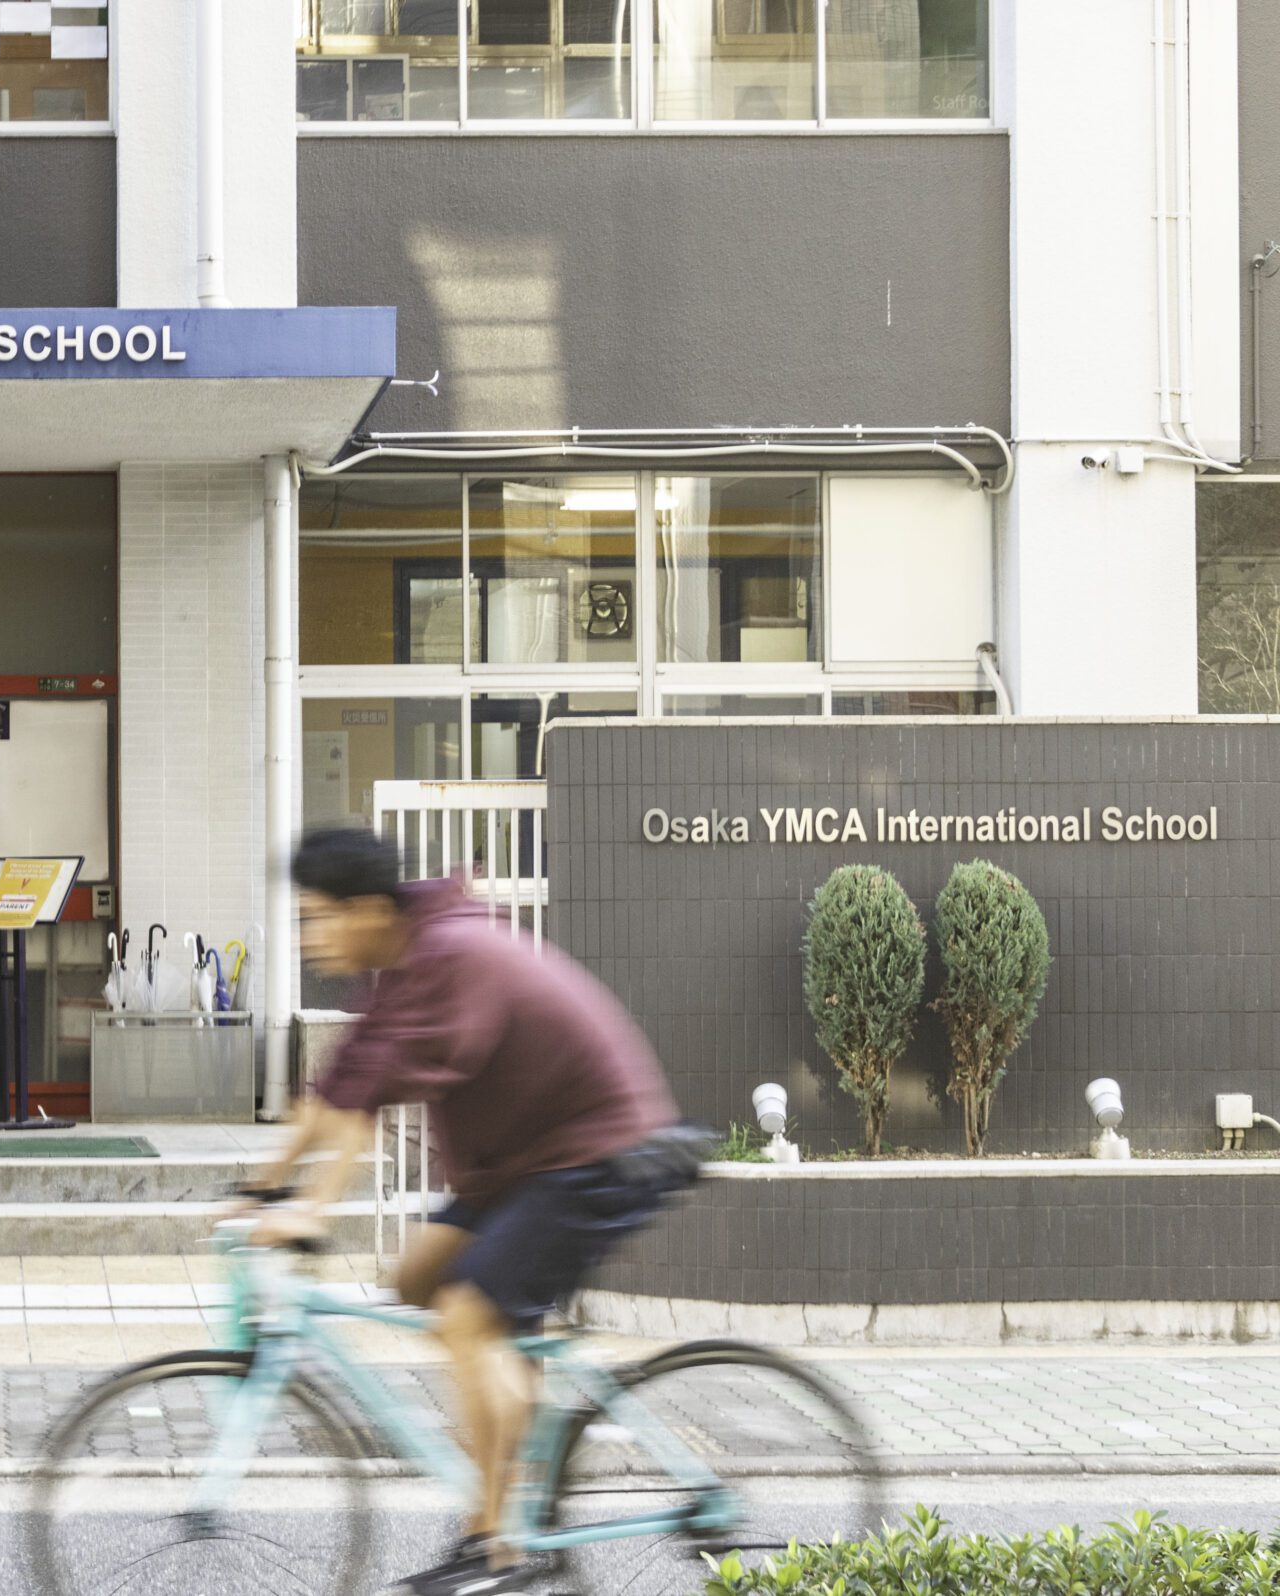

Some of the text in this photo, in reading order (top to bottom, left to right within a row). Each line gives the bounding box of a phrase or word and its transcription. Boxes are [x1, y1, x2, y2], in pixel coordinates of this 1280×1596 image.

[933, 93, 989, 110] Staff Ro
[642, 806, 1218, 843] Osaka YMCA International School
